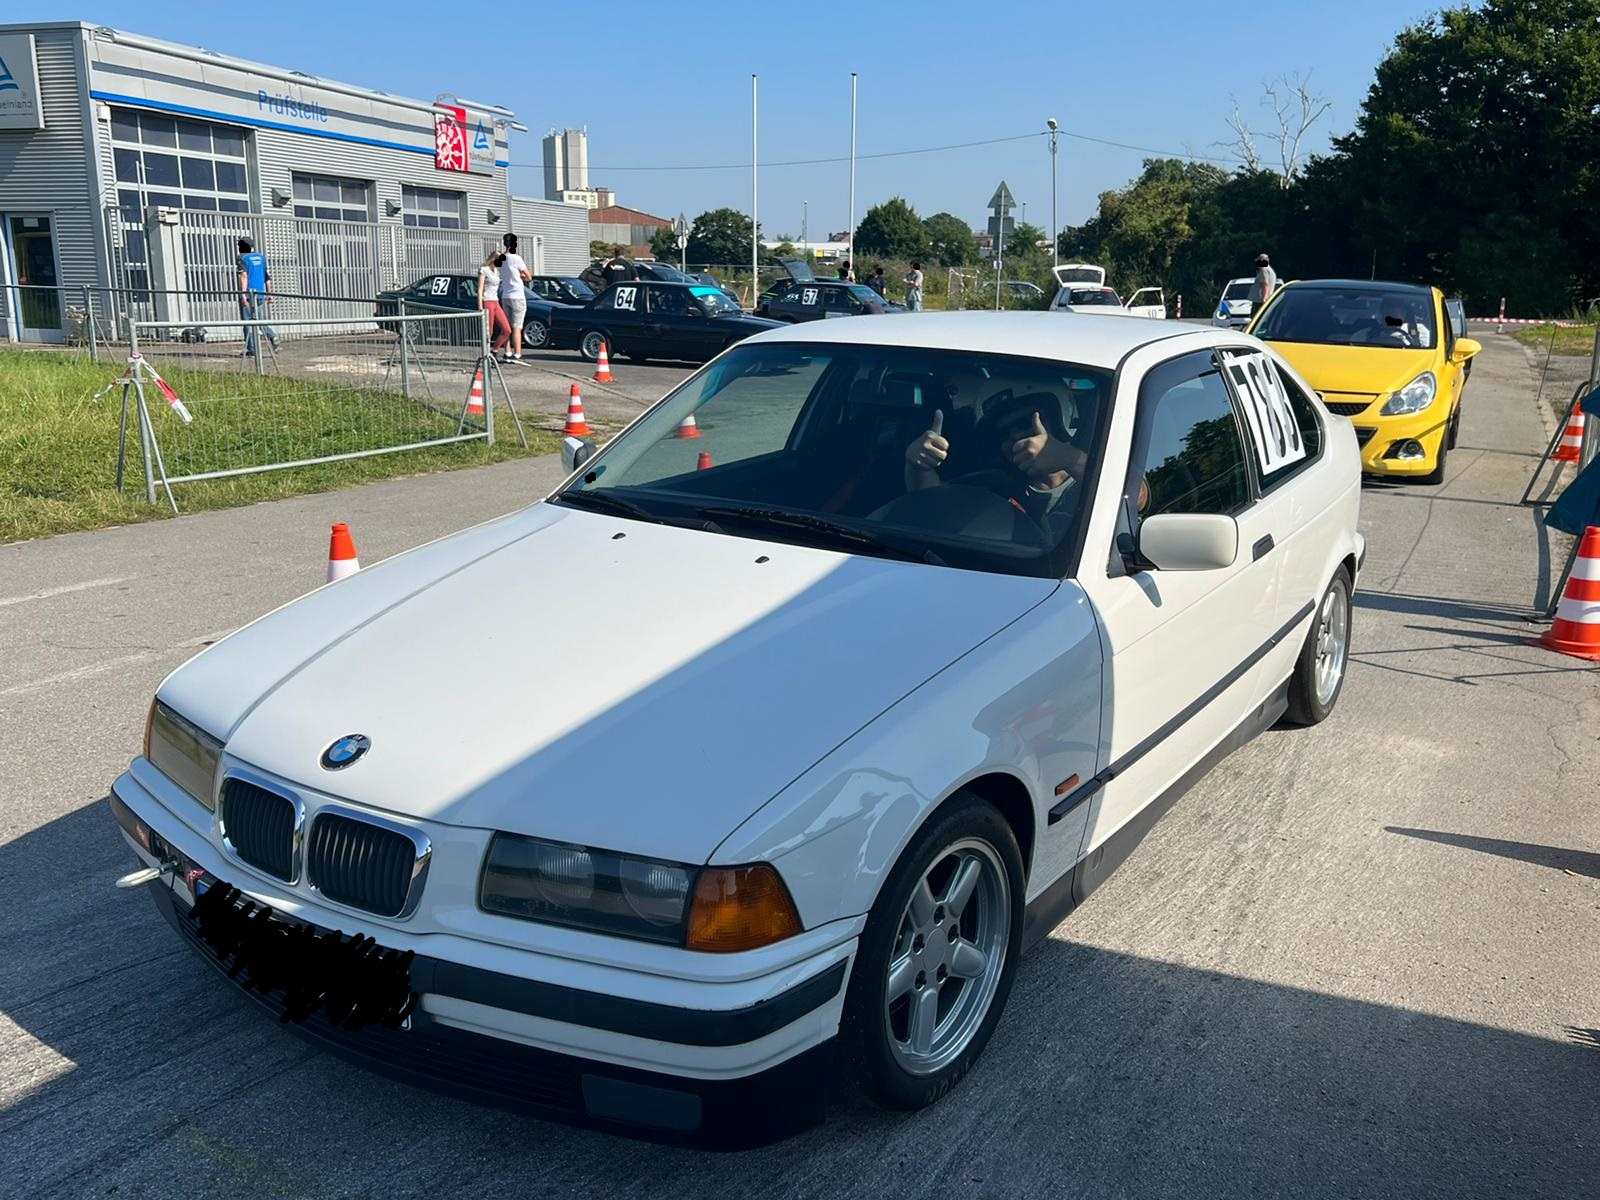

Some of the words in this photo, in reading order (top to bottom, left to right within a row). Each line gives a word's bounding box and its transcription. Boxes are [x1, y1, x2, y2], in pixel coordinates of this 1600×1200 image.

[0, 99, 32, 109] einland
[258, 90, 328, 122] Prüfstelle
[434, 278, 448, 294] 52
[616, 289, 634, 307] 64
[803, 289, 817, 304] 57
